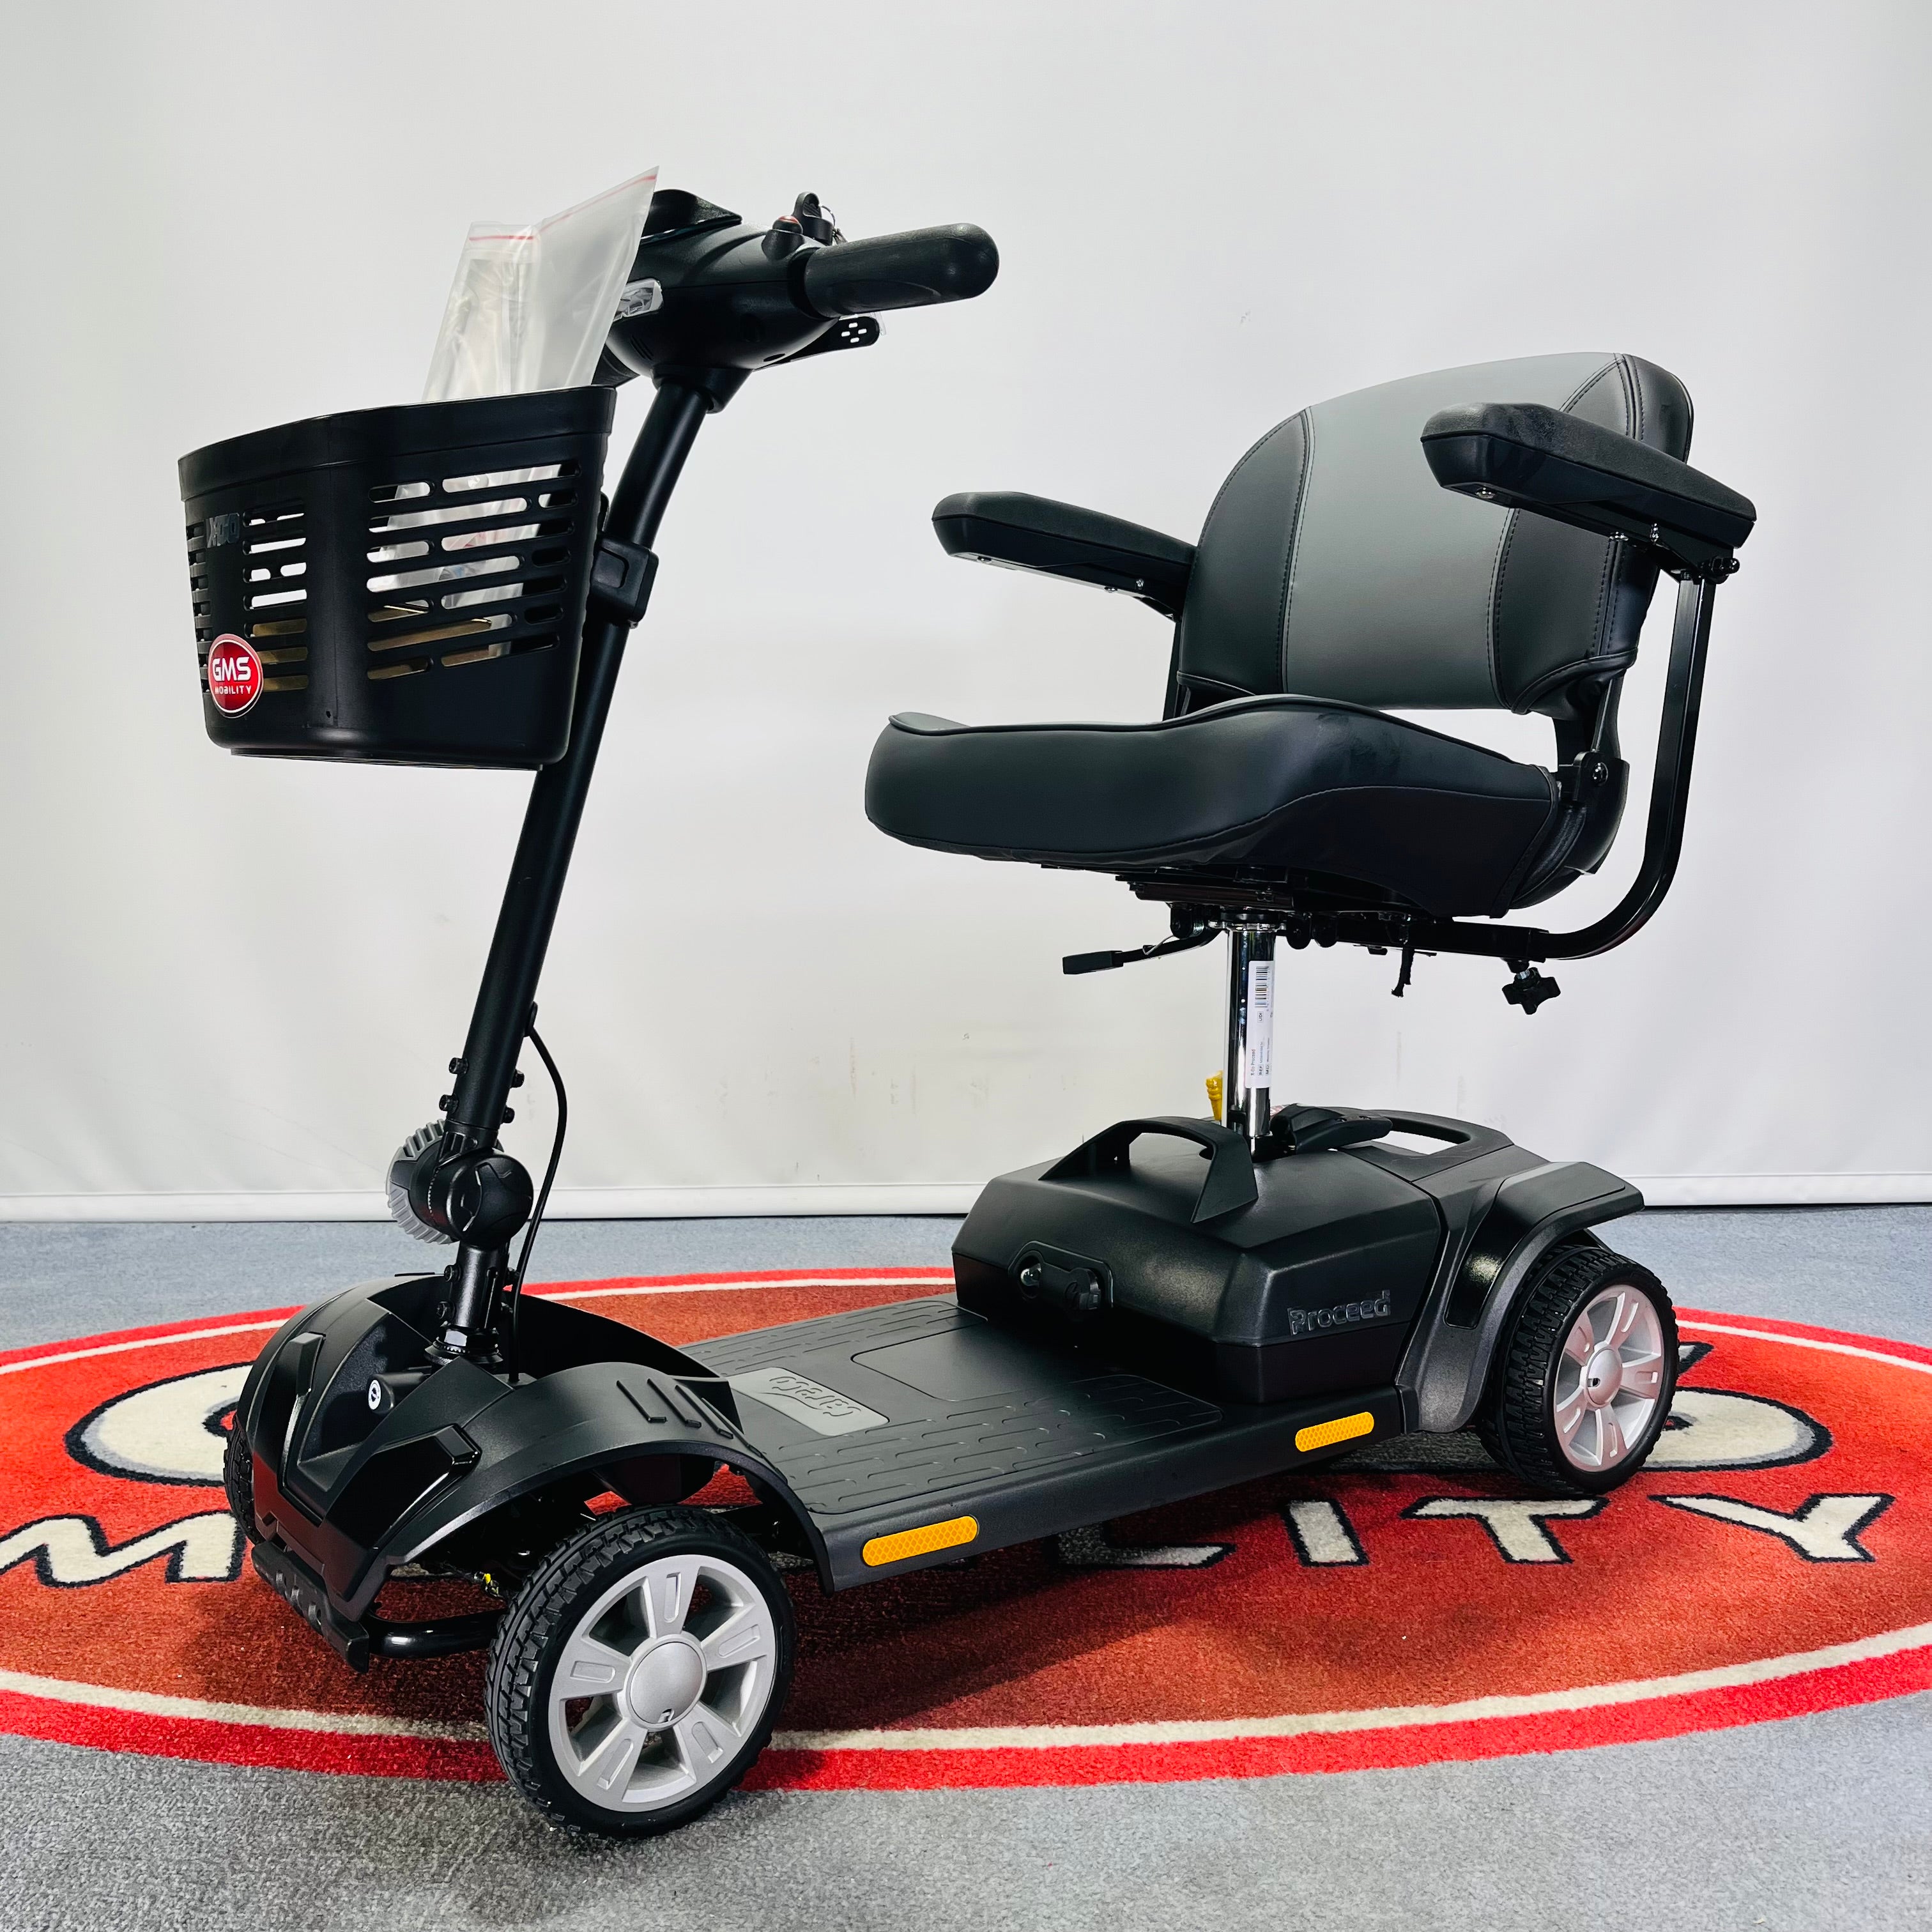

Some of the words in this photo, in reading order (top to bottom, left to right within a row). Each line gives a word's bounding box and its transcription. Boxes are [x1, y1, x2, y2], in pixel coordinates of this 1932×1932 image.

[212, 657, 251, 681] GMS
[214, 685, 252, 695] MOBILITY
[1287, 1289, 1391, 1336] Proceed
